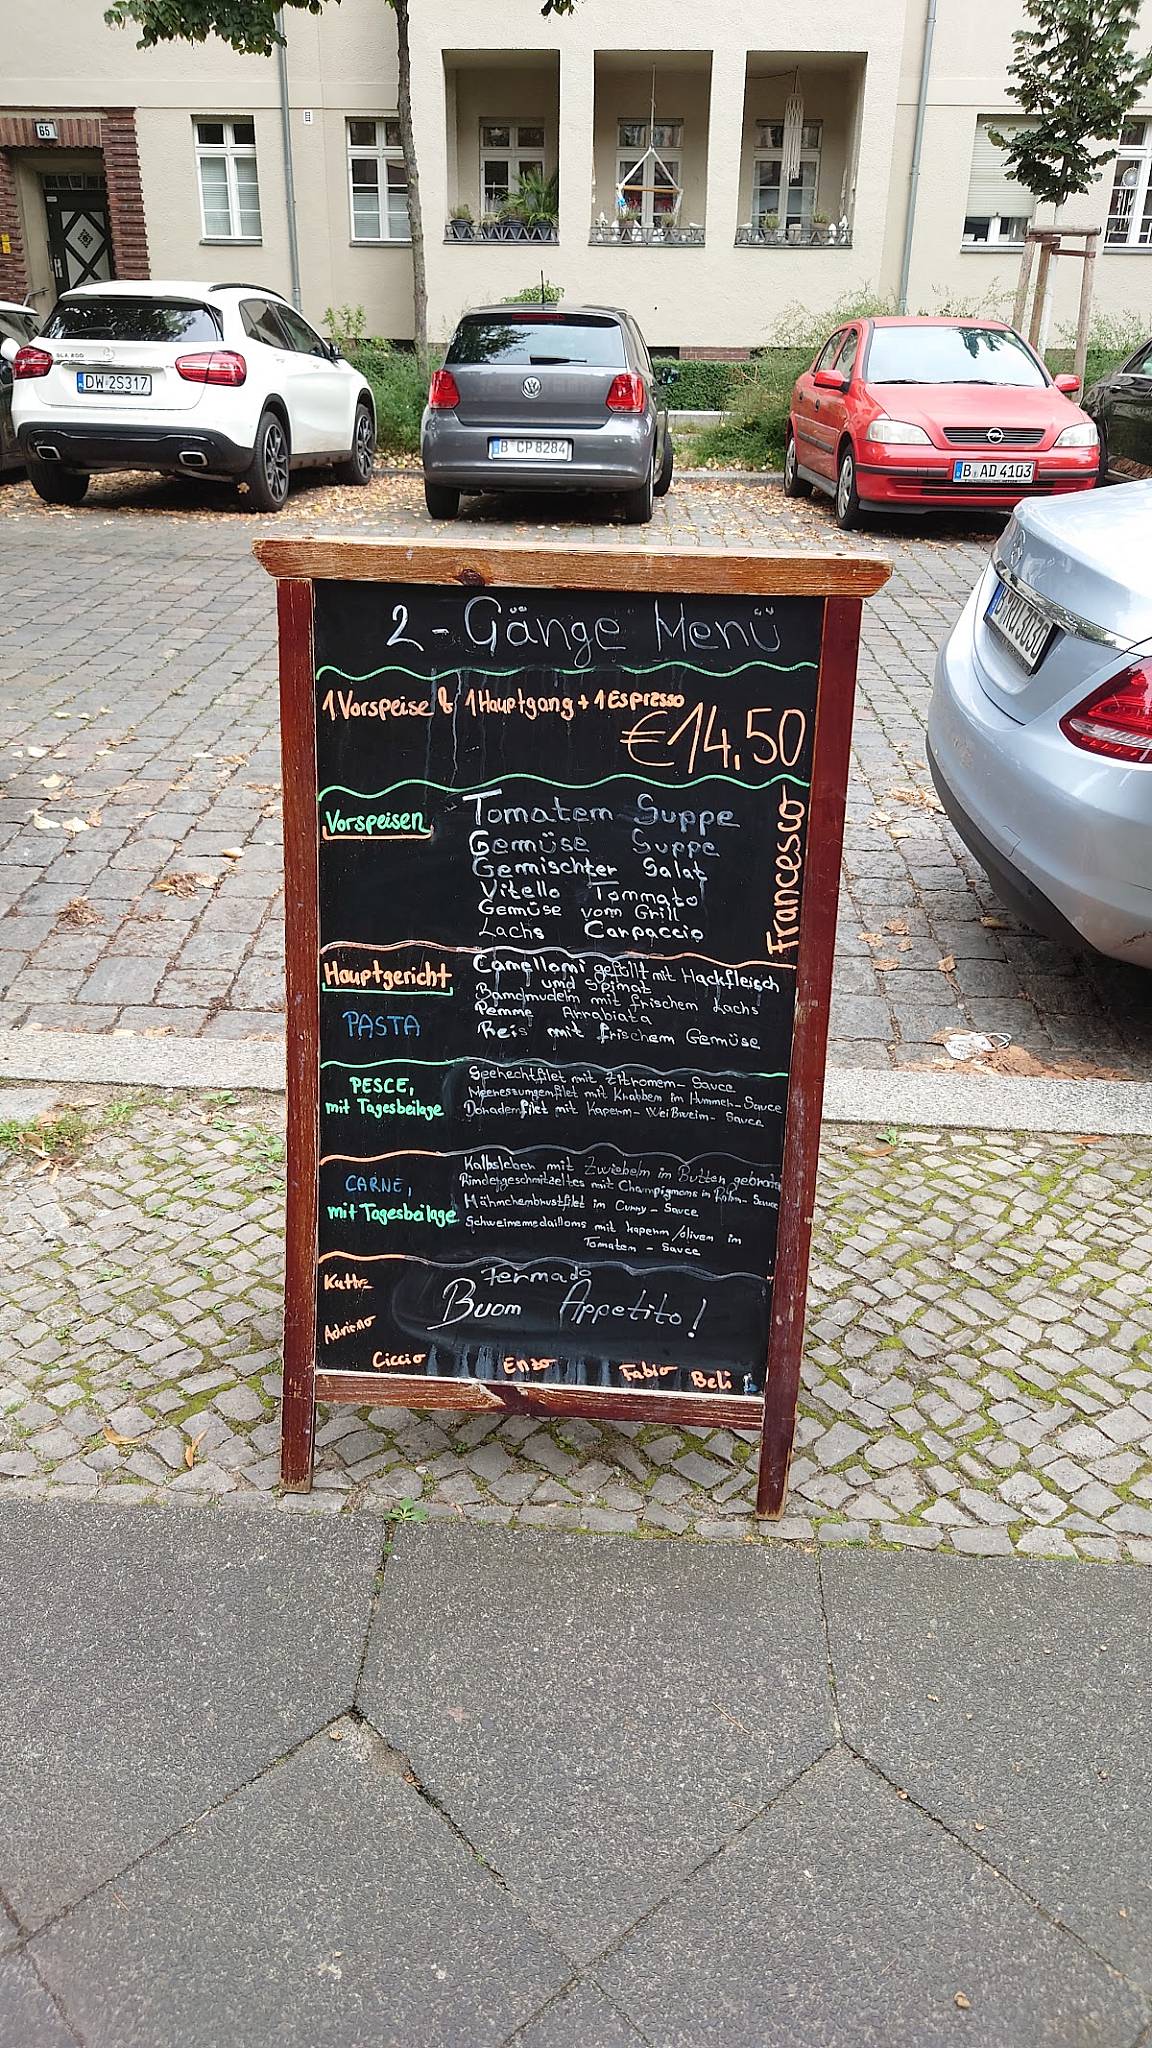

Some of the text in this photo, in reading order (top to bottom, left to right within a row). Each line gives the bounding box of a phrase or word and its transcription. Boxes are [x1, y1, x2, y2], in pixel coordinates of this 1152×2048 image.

[38, 125, 51, 137] 65
[85, 374, 148, 390] DW 2S317
[500, 440, 509, 453] B
[535, 441, 566, 454] 8284
[963, 464, 1032, 478] B AD 4103
[385, 604, 424, 652] 2
[463, 595, 627, 669] Gänge
[653, 599, 782, 653] Menü
[325, 808, 432, 835] Vorspeisen
[633, 793, 741, 837] Suppe
[468, 828, 721, 859] Gemüse Suppe
[472, 856, 708, 882] Gemischter Salat
[765, 784, 806, 956] Francesco
[479, 879, 561, 900] Vitello
[477, 898, 563, 917] Gemüse
[634, 904, 681, 922] Grill
[478, 917, 705, 943] Lachs Carpaccio
[323, 959, 453, 991] Hauptgericht
[652, 965, 677, 982] mit
[681, 967, 780, 994] Hackfleisch
[590, 990, 622, 1008] mit
[629, 993, 699, 1012] frischem
[712, 997, 760, 1016] Lachs
[342, 1010, 422, 1039] PASTA
[477, 1020, 761, 1050] Reis mit frischem Gemüse
[350, 1076, 415, 1097] PESCE,
[571, 1070, 598, 1084] mit
[691, 1076, 737, 1093] Sauce
[583, 1085, 608, 1100] mit
[324, 1098, 446, 1121] mit Tagesbeilage
[554, 1101, 579, 1117] mit
[725, 1112, 765, 1128] Sauce
[546, 1156, 575, 1172] mit
[590, 1177, 615, 1190] mit
[327, 1202, 357, 1221] mit
[663, 1203, 699, 1218] Sauce
[593, 1220, 617, 1233] mit
[661, 1242, 701, 1257] Sauce
[371, 1350, 427, 1369] Ciccio
[618, 1360, 680, 1383] Fabio
